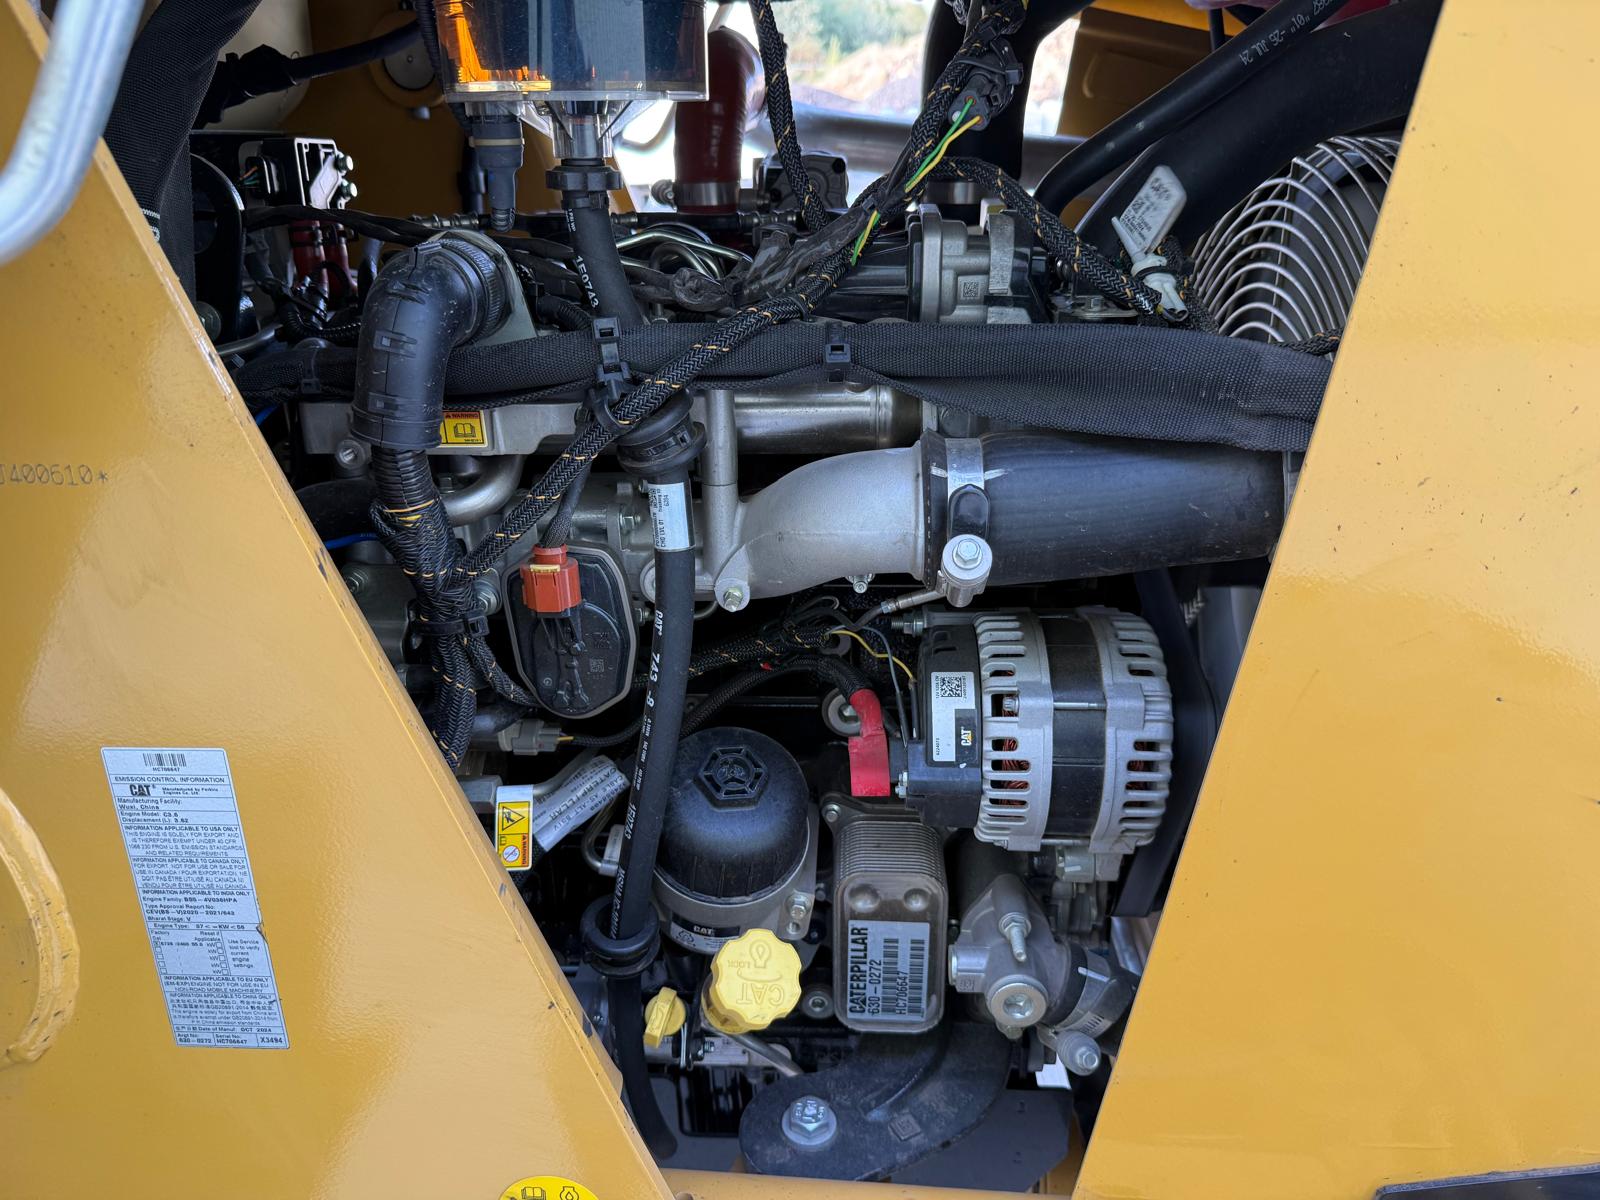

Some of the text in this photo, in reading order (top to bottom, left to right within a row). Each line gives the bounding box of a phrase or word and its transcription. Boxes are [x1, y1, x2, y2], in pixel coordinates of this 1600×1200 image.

[650, 652, 660, 682] 743
[550, 766, 618, 821] CATERPILLAR
[849, 928, 868, 1014] CATERPILLAR
[736, 982, 786, 1006] CAT
